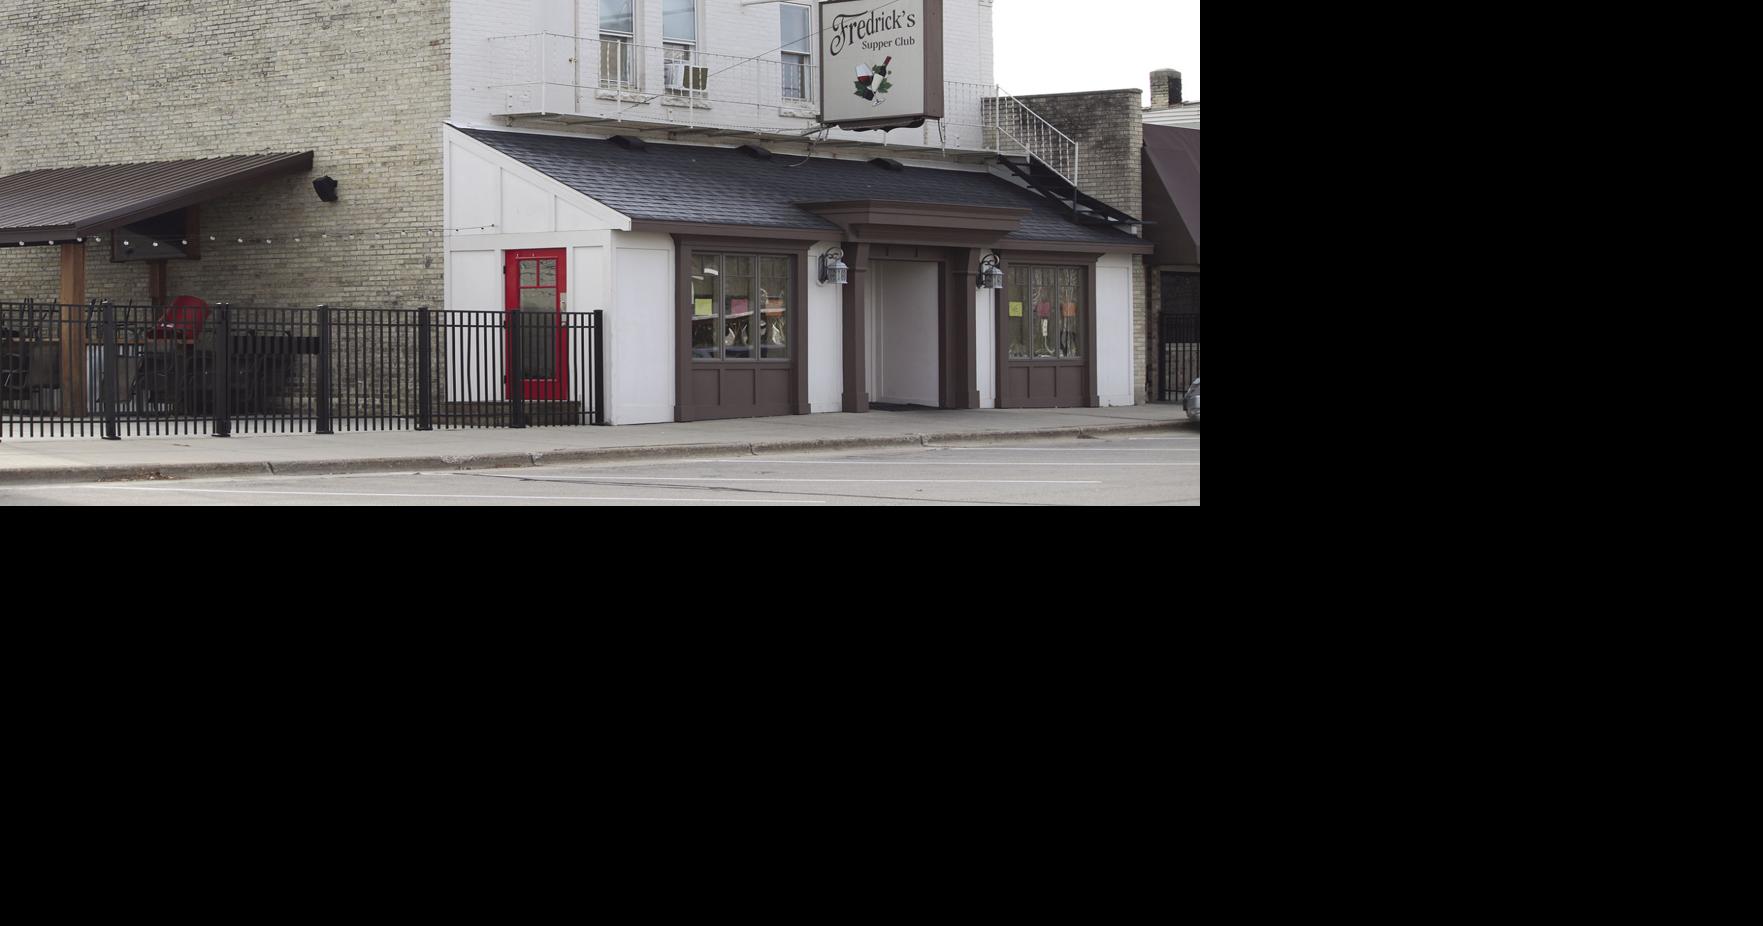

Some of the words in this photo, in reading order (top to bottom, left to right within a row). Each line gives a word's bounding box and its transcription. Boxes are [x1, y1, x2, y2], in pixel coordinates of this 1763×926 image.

[830, 10, 916, 56] Fredrick's
[861, 40, 893, 51] Supper
[894, 36, 915, 46] Club
